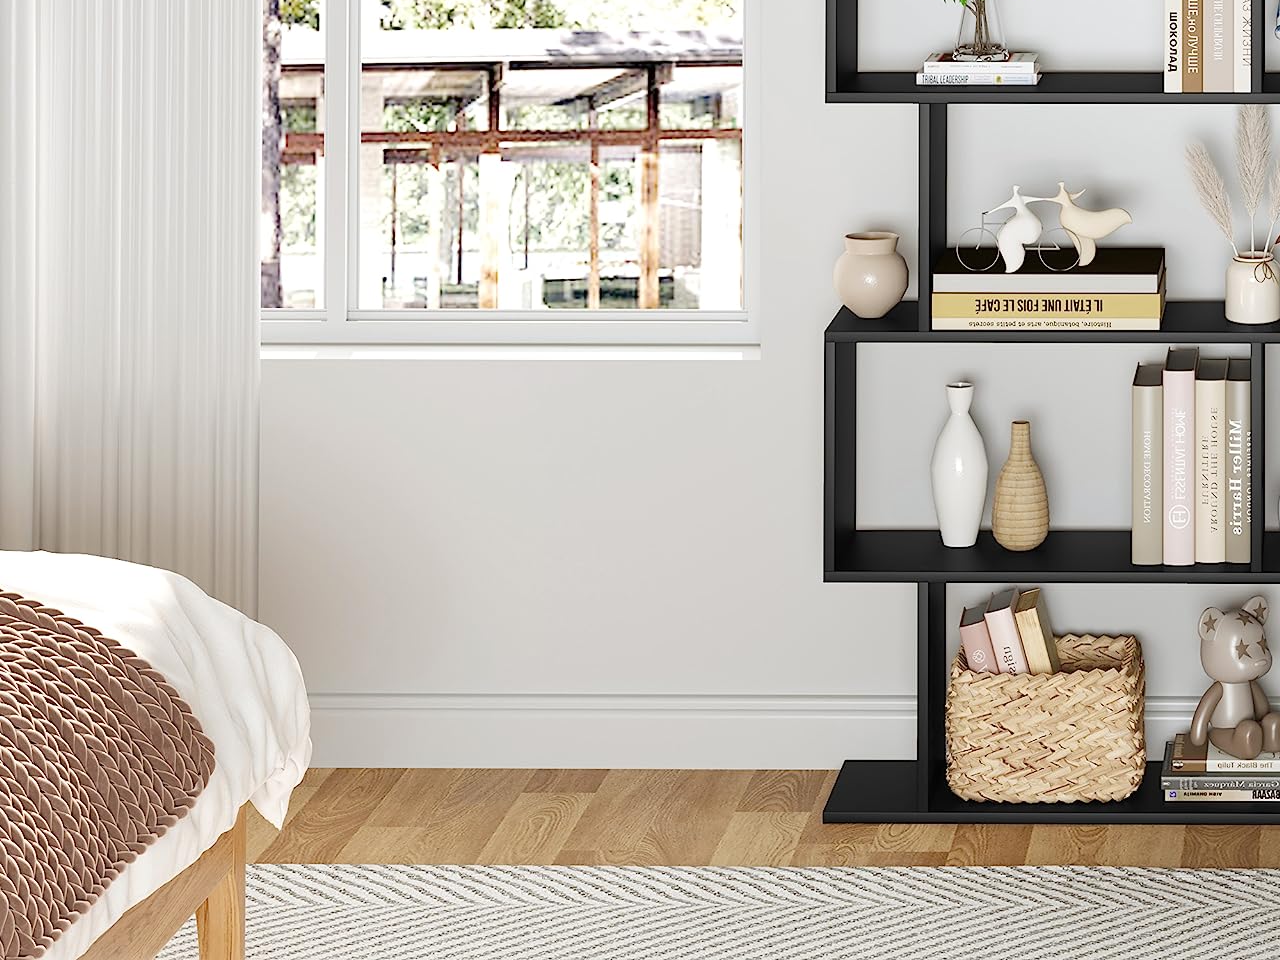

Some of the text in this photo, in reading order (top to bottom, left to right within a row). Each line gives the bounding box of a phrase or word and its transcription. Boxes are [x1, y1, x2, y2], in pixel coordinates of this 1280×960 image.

[1167, 12, 1178, 72] ШОКОЛАД
[1187, 35, 1199, 73] ЛУЧШЕ
[922, 75, 939, 84] TRIBAL
[940, 75, 969, 84] LEADERSHIP
[975, 300, 1103, 314] IL ÉTAIT UNE FOIS LE CAFÉ
